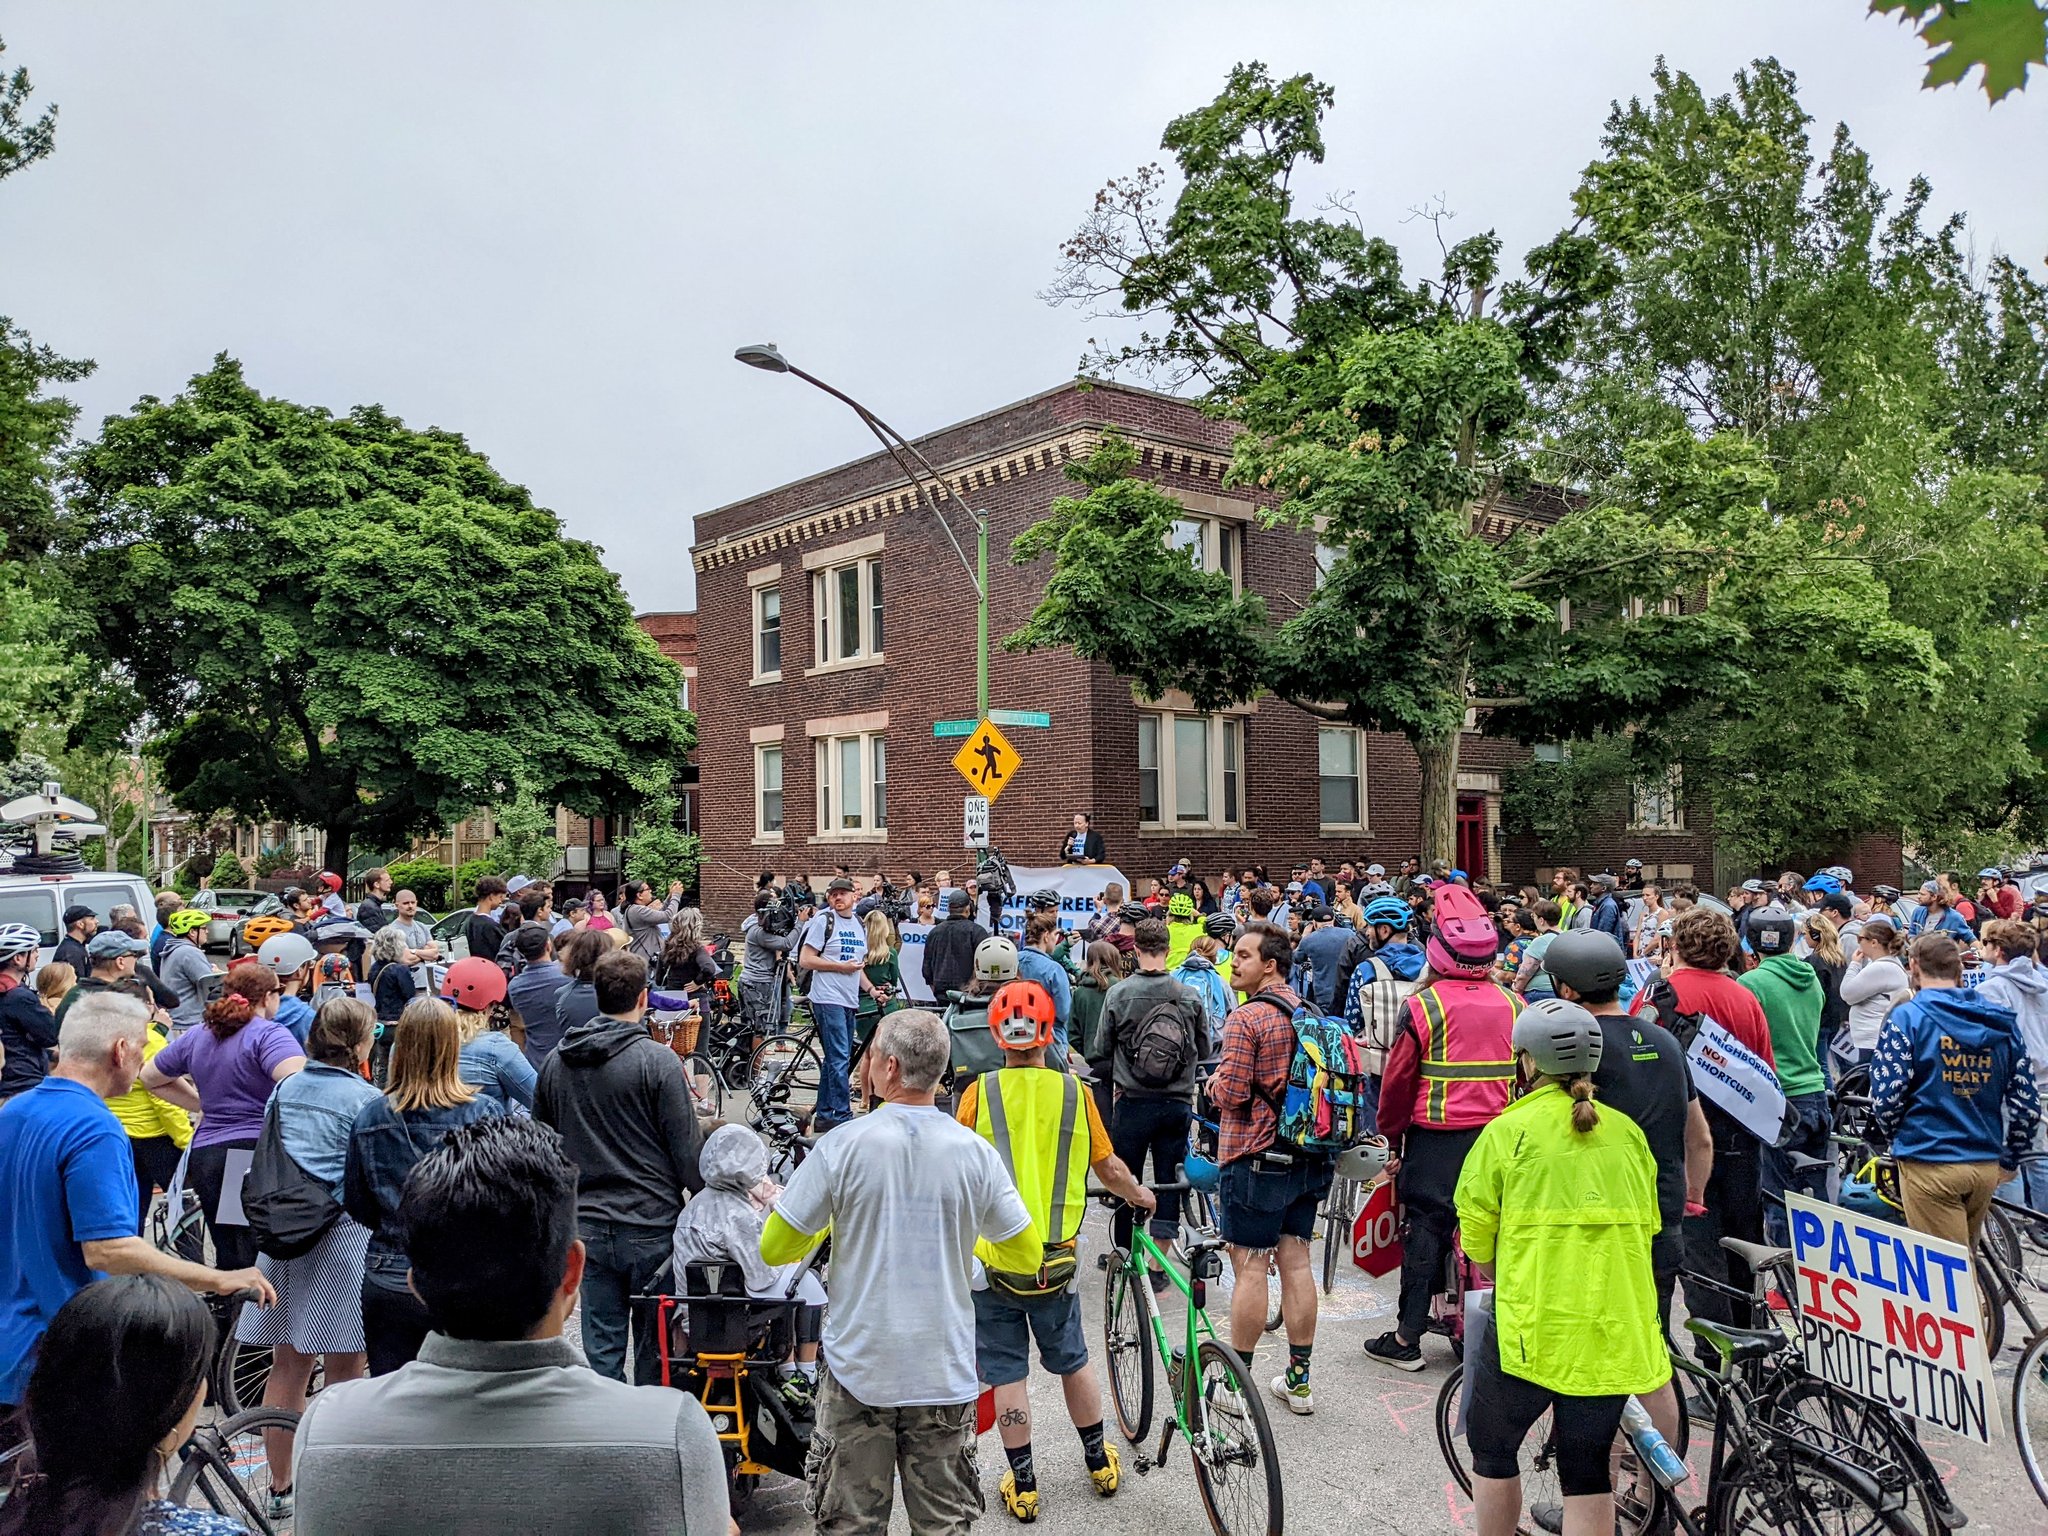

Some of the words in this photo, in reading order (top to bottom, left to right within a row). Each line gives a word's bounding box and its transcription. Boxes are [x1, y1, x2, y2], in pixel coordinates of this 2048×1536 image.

[968, 801, 985, 813] ONE
[968, 815, 985, 826] WAY
[1001, 895, 1034, 909] AFE
[838, 930, 856, 938] SAFE
[1702, 1044, 1728, 1065] NOT
[1941, 1053, 1992, 1068] WITH
[1942, 1070, 1992, 1083] HEART
[1355, 1209, 1400, 1258] OP
[1791, 1208, 1968, 1313] PAINT
[1798, 1266, 1862, 1332] IS
[1882, 1298, 1975, 1372] NOT
[1801, 1314, 1989, 1445] PROTECTION
